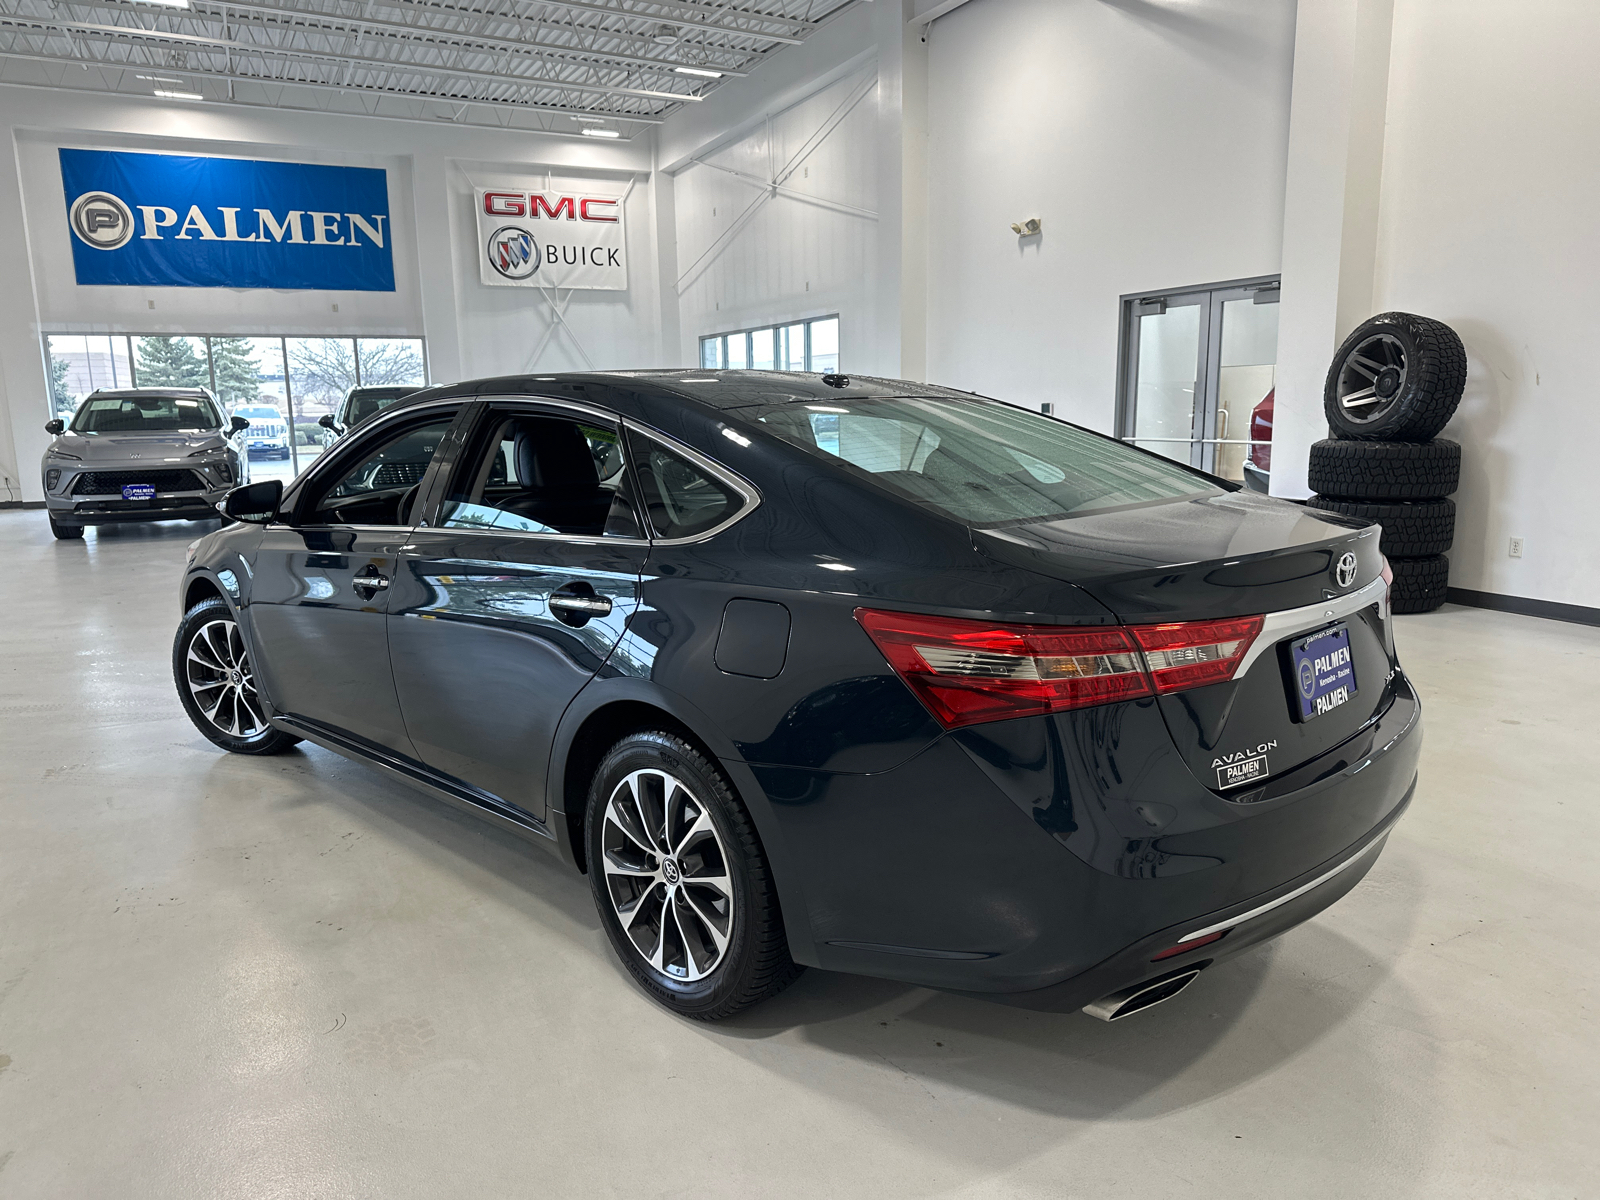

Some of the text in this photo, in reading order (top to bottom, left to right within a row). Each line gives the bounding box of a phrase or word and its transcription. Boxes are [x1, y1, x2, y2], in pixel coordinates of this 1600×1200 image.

[483, 190, 620, 224] GMC
[136, 204, 387, 249] PALMEN
[546, 244, 621, 267] BUICK
[1306, 627, 1338, 645] palmen.com
[1314, 645, 1351, 677] PALMEN
[1319, 674, 1337, 688] Kenosha
[1337, 667, 1351, 679] Racine
[1316, 685, 1349, 716] PALMEN
[1210, 739, 1278, 769] AVALON
[1227, 760, 1260, 779] PALMEN
